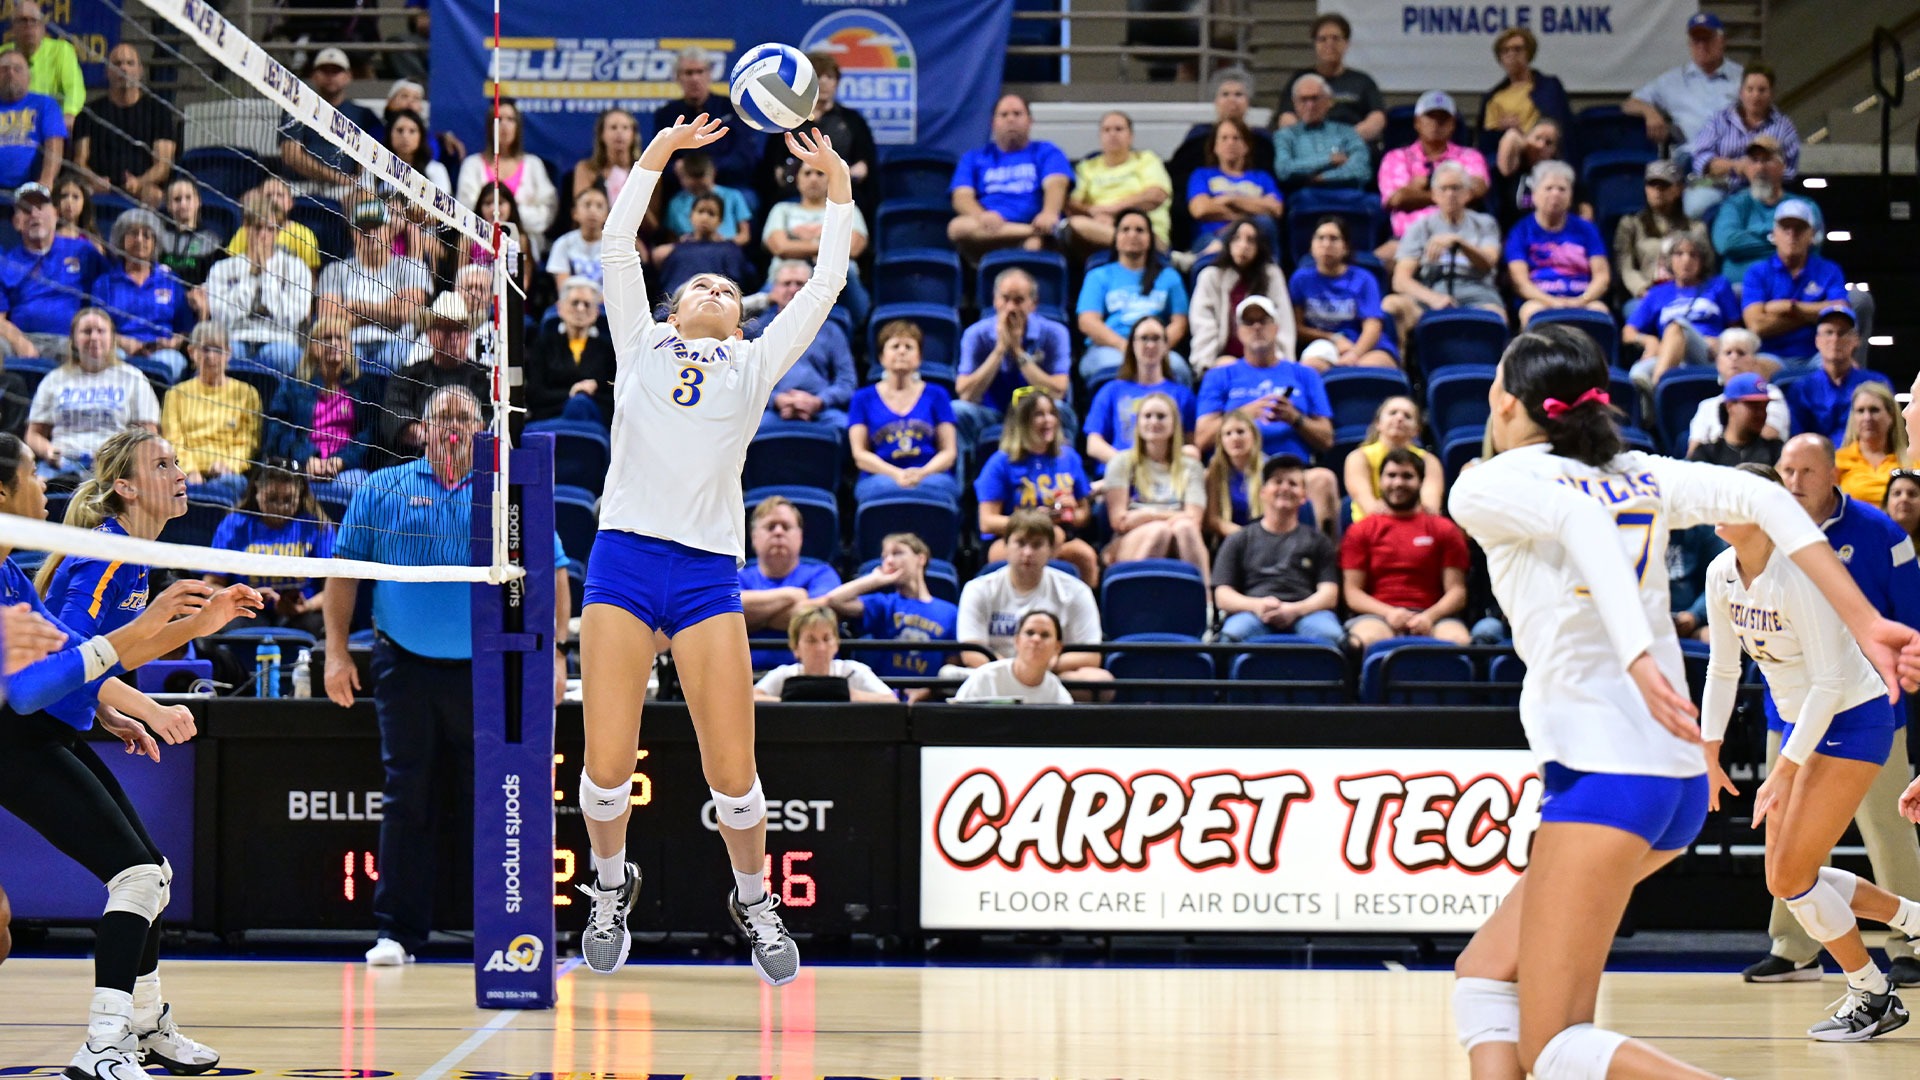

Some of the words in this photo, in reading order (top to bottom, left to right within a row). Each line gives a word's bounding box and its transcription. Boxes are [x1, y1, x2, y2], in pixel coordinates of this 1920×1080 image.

[1403, 6, 1531, 34] PINNACLE
[1541, 6, 1613, 34] BANK
[671, 365, 705, 408] 3
[509, 504, 520, 550] sports
[1750, 607, 1783, 632] STATE
[288, 791, 384, 820] BELLE
[502, 774, 522, 835] sports
[701, 800, 834, 831] GEST
[933, 766, 1314, 872] CARPET
[502, 838, 523, 914] imports
[978, 891, 1069, 912] FLOOR
[1079, 892, 1147, 912] CARE
[1178, 892, 1223, 913] AIR
[1232, 892, 1322, 914] DUCTS
[1353, 893, 1501, 916] RESTORATI
[483, 940, 544, 973] ASU
